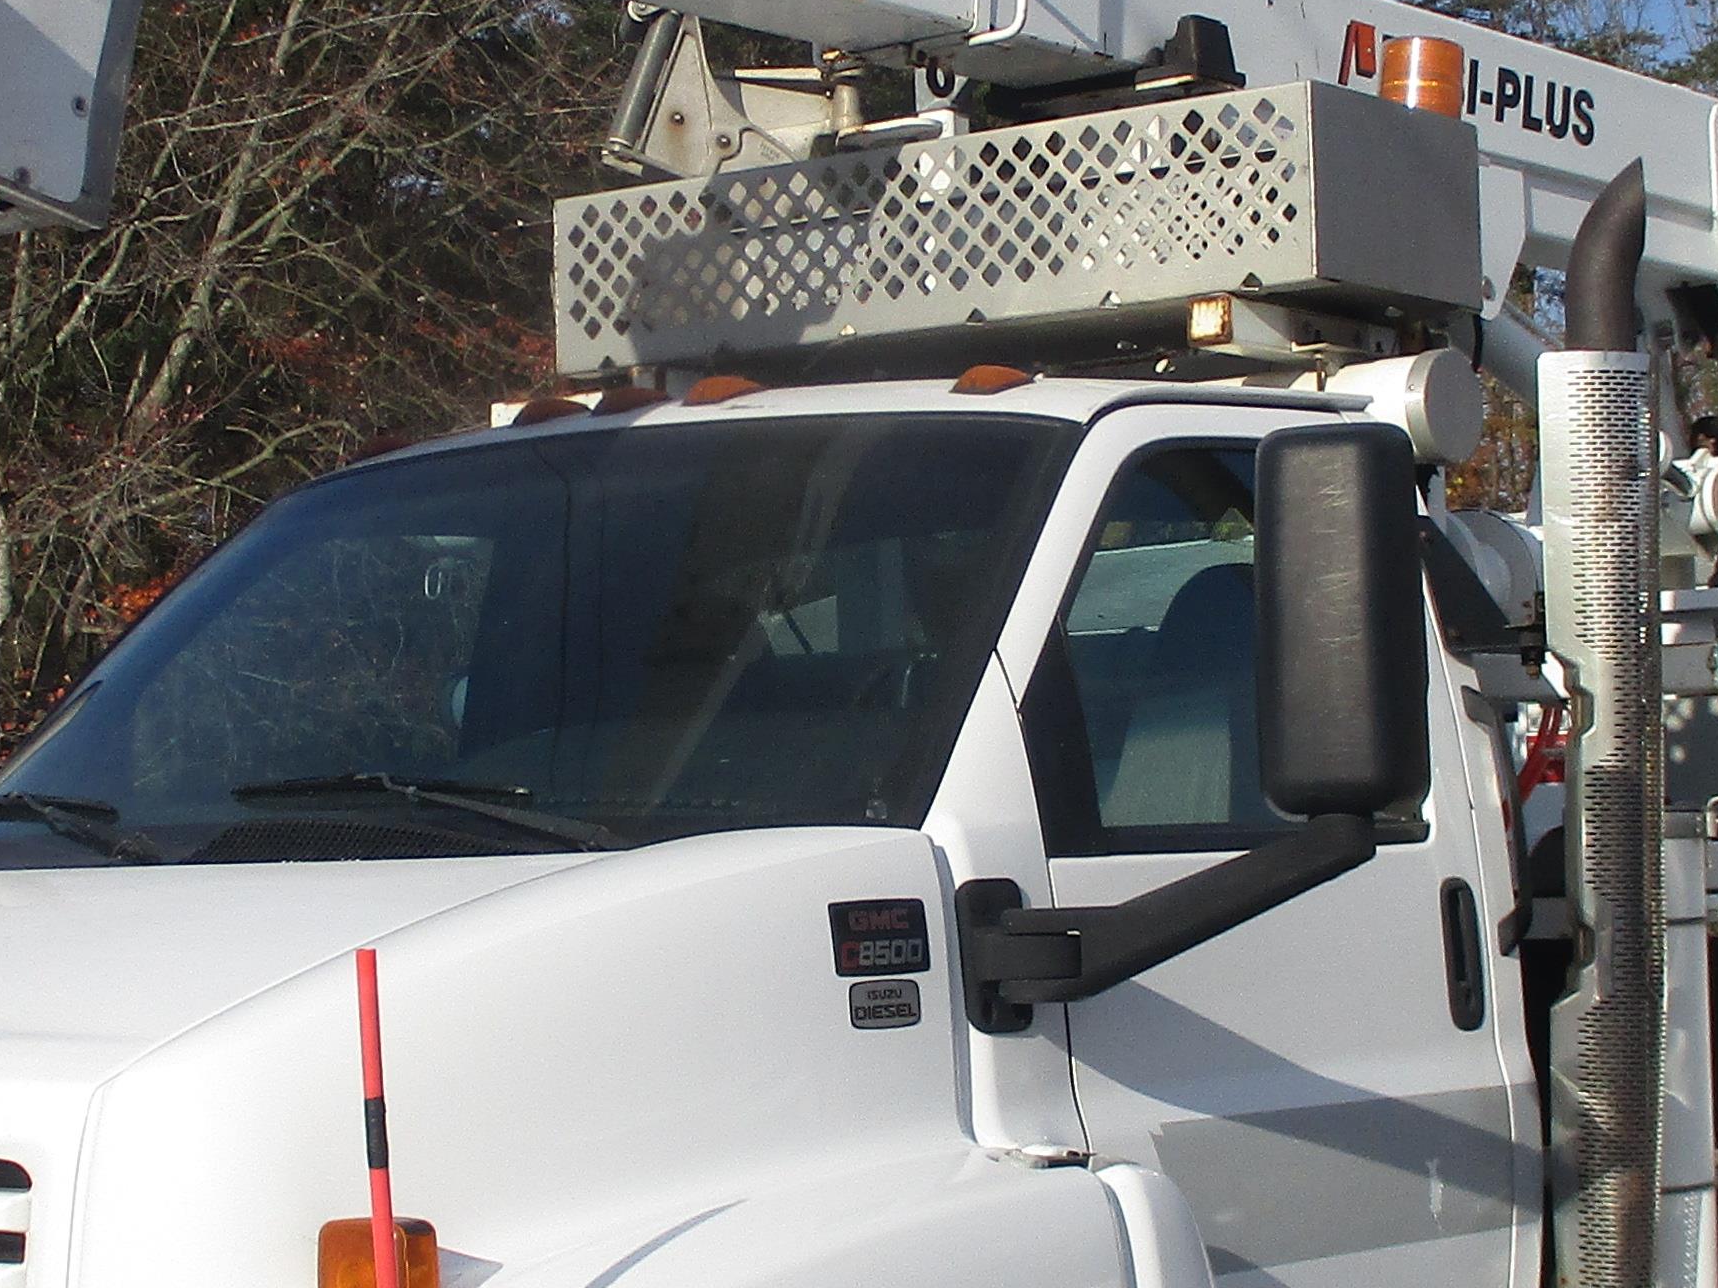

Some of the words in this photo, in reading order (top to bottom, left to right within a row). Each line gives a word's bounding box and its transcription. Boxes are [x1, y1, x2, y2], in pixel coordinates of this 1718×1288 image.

[848, 909, 909, 931] GMC
[841, 938, 923, 970] C8500
[867, 989, 903, 1001] ISUZU
[853, 1003, 917, 1021] DIESEL
